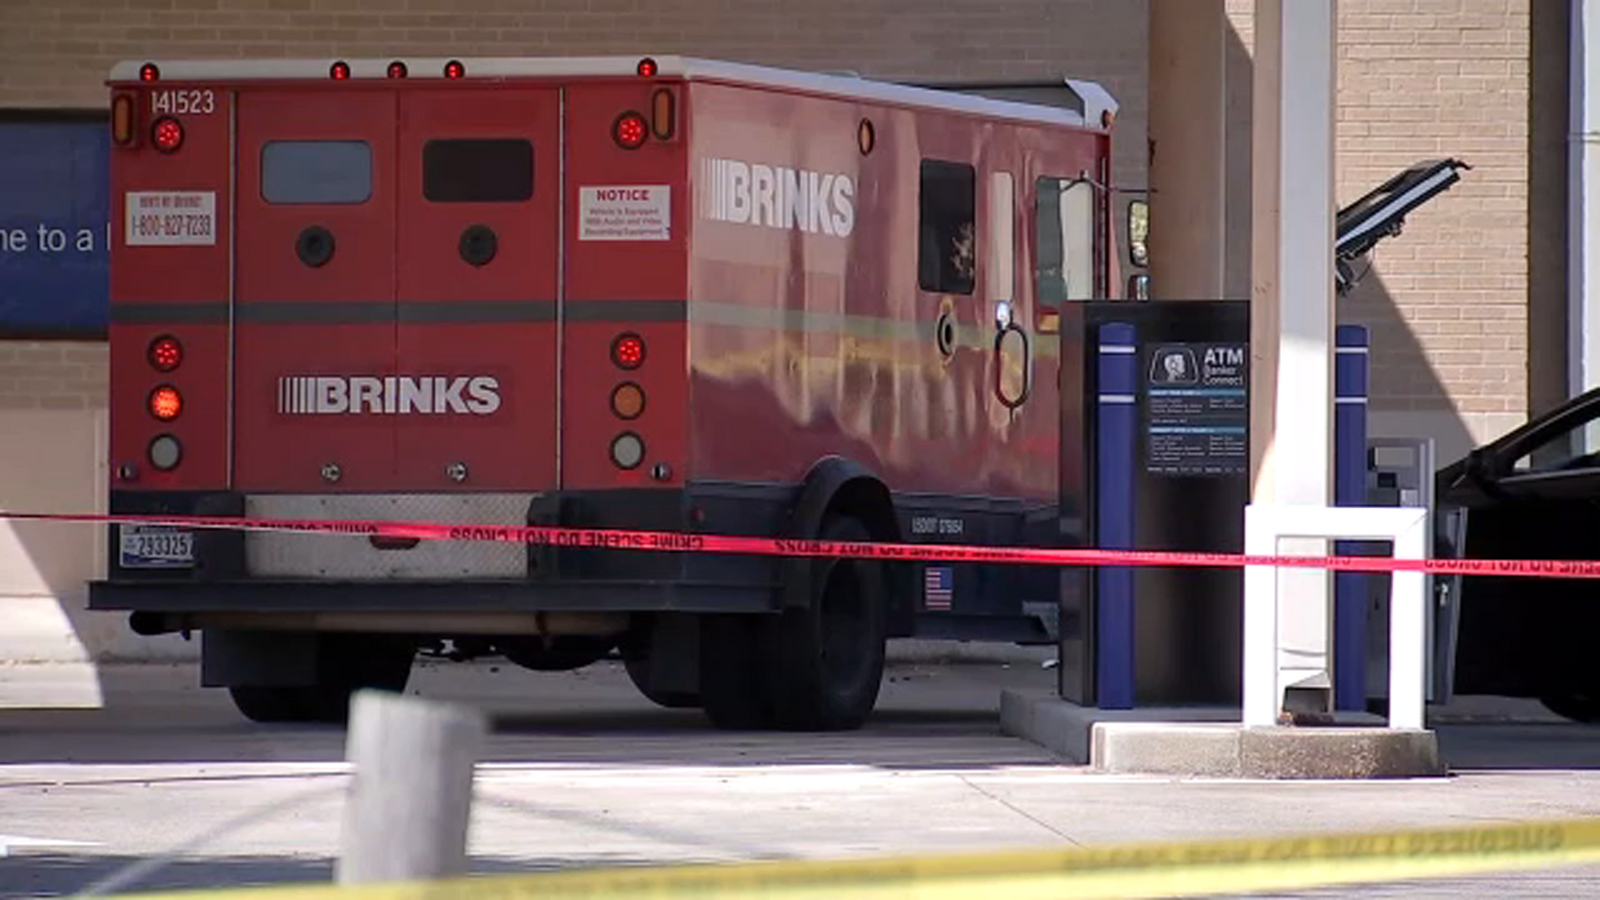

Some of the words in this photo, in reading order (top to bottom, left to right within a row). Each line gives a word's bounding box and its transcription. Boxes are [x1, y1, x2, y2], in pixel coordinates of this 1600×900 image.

[151, 90, 214, 114] 141523
[596, 189, 651, 201] NOTICE
[727, 159, 855, 238] BRINKS
[37, 223, 66, 252] to
[76, 229, 94, 252] a
[1204, 347, 1244, 365] ATM
[315, 376, 502, 415] BRINKS
